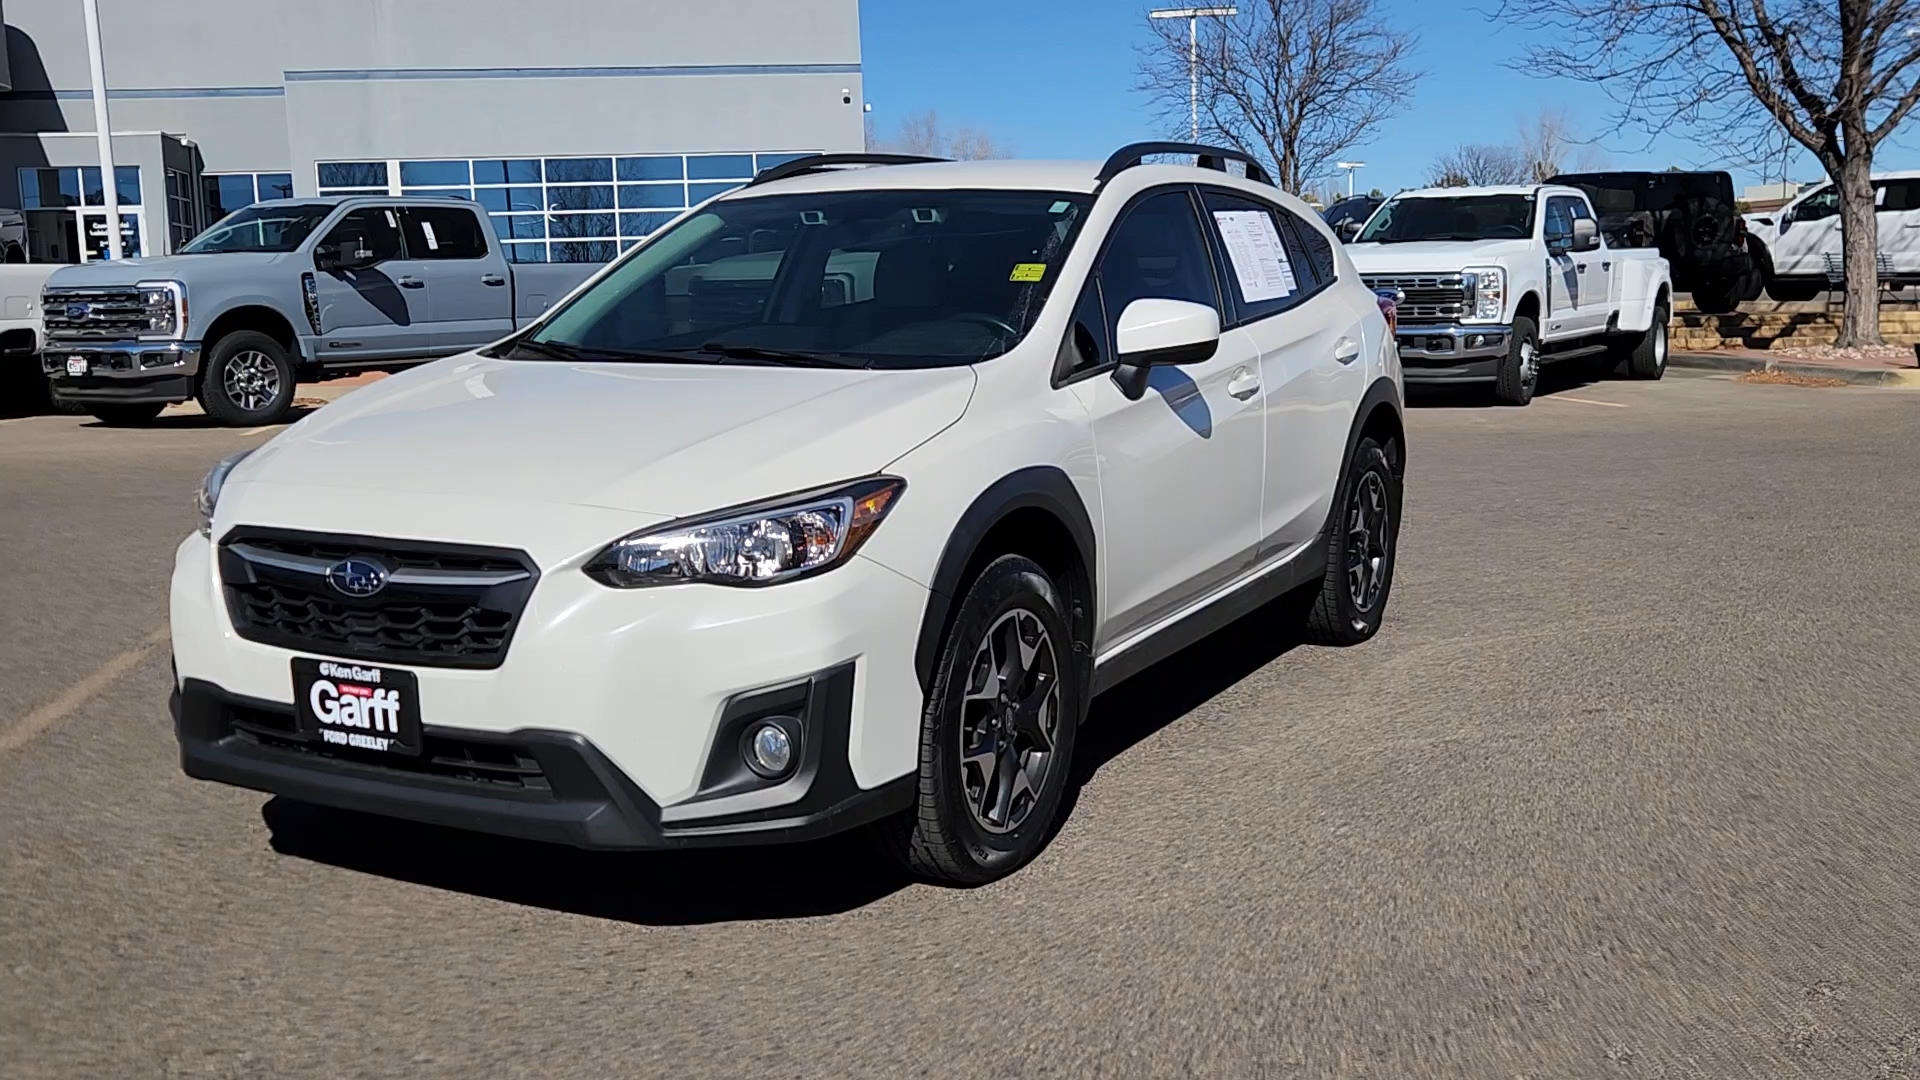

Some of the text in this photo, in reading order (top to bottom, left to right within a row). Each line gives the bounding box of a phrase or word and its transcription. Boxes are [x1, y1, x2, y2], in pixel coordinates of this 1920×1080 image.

[330, 664, 352, 680] Ken
[352, 667, 381, 683] Garff
[310, 679, 400, 733] Garff
[323, 729, 389, 751] FORD GREELEY
